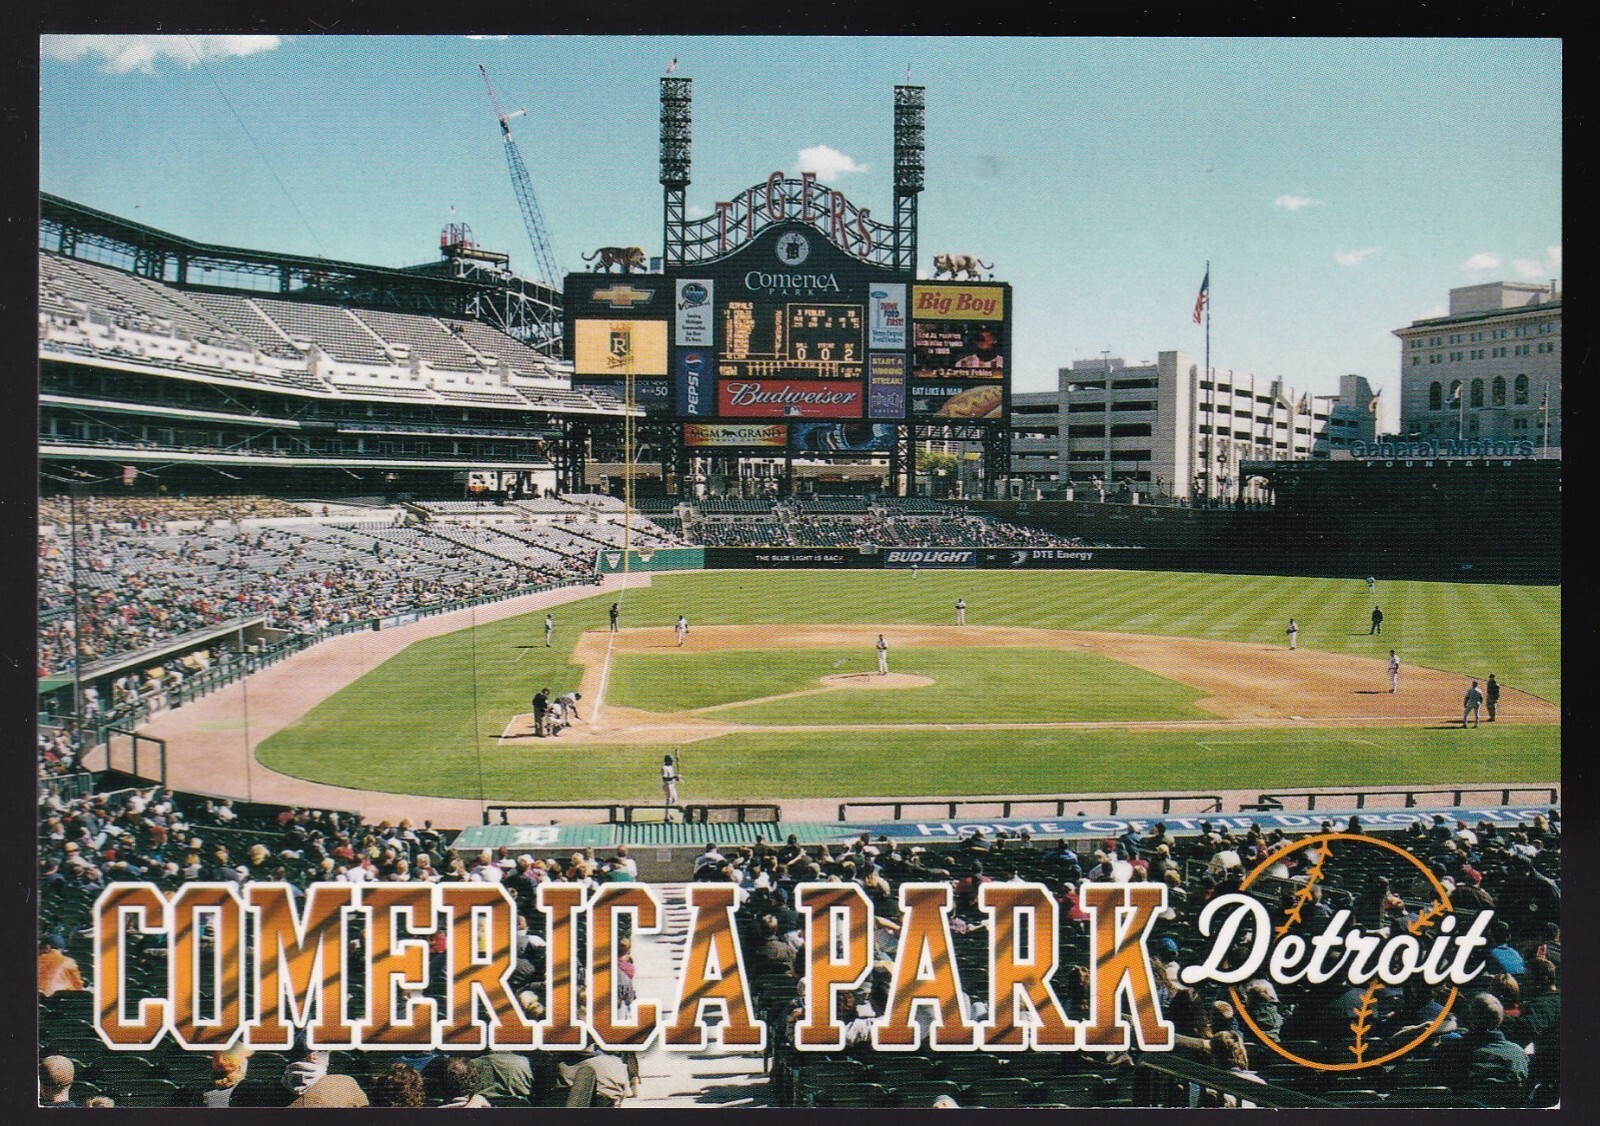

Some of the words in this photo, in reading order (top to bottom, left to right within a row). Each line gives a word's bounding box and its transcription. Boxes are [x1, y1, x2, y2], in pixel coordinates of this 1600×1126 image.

[715, 171, 872, 258] TIGERS
[769, 288, 815, 296] PARK
[917, 292, 953, 315] Big
[956, 293, 997, 316] Boy
[797, 348, 806, 360] 0
[821, 348, 830, 360] 0
[844, 349, 853, 361] 2
[872, 357, 895, 365] START
[655, 386, 668, 396] 50
[688, 371, 699, 415] PEPSI
[726, 382, 856, 406] Budweiser
[912, 387, 924, 396] EAT
[925, 387, 939, 396] LIKE
[691, 429, 720, 438] MGM
[737, 428, 781, 438] GRAND
[1350, 438, 1439, 458] General
[1450, 438, 1535, 458] Motors
[1366, 460, 1513, 468] FOUNTAIN
[887, 551, 924, 563] BUD
[923, 551, 973, 563] LIGHT
[1032, 550, 1055, 559] DTE
[1056, 550, 1094, 561] Energy
